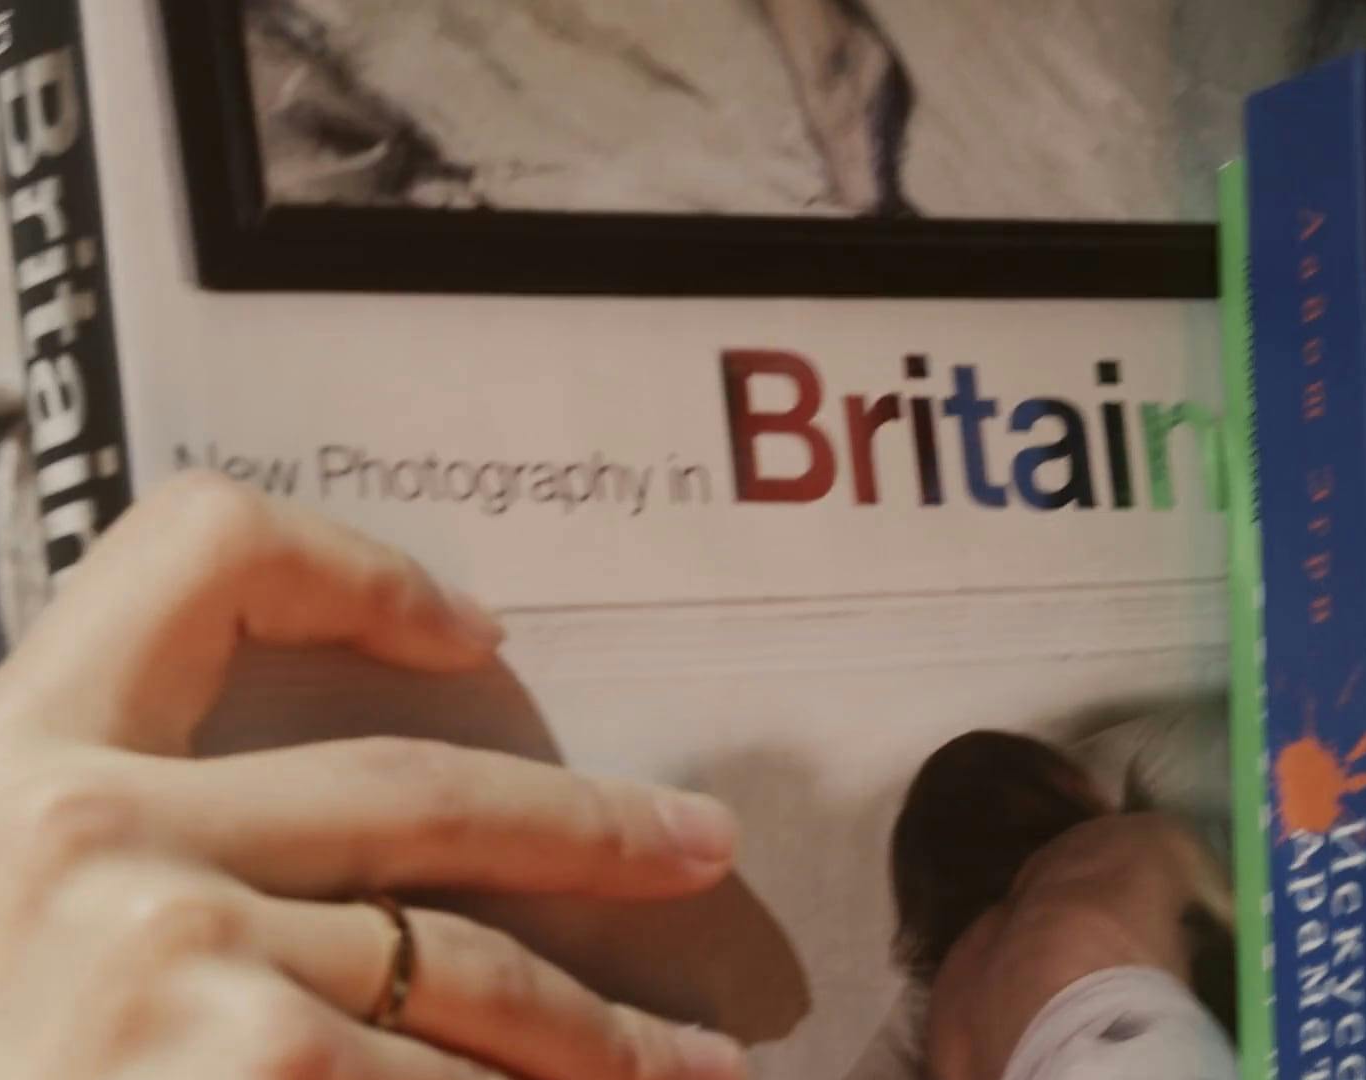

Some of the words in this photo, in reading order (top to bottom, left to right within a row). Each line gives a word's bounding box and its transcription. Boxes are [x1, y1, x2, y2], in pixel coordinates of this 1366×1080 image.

[317, 443, 653, 516] Photography
[667, 454, 713, 501] in
[719, 347, 1233, 512] Britain
